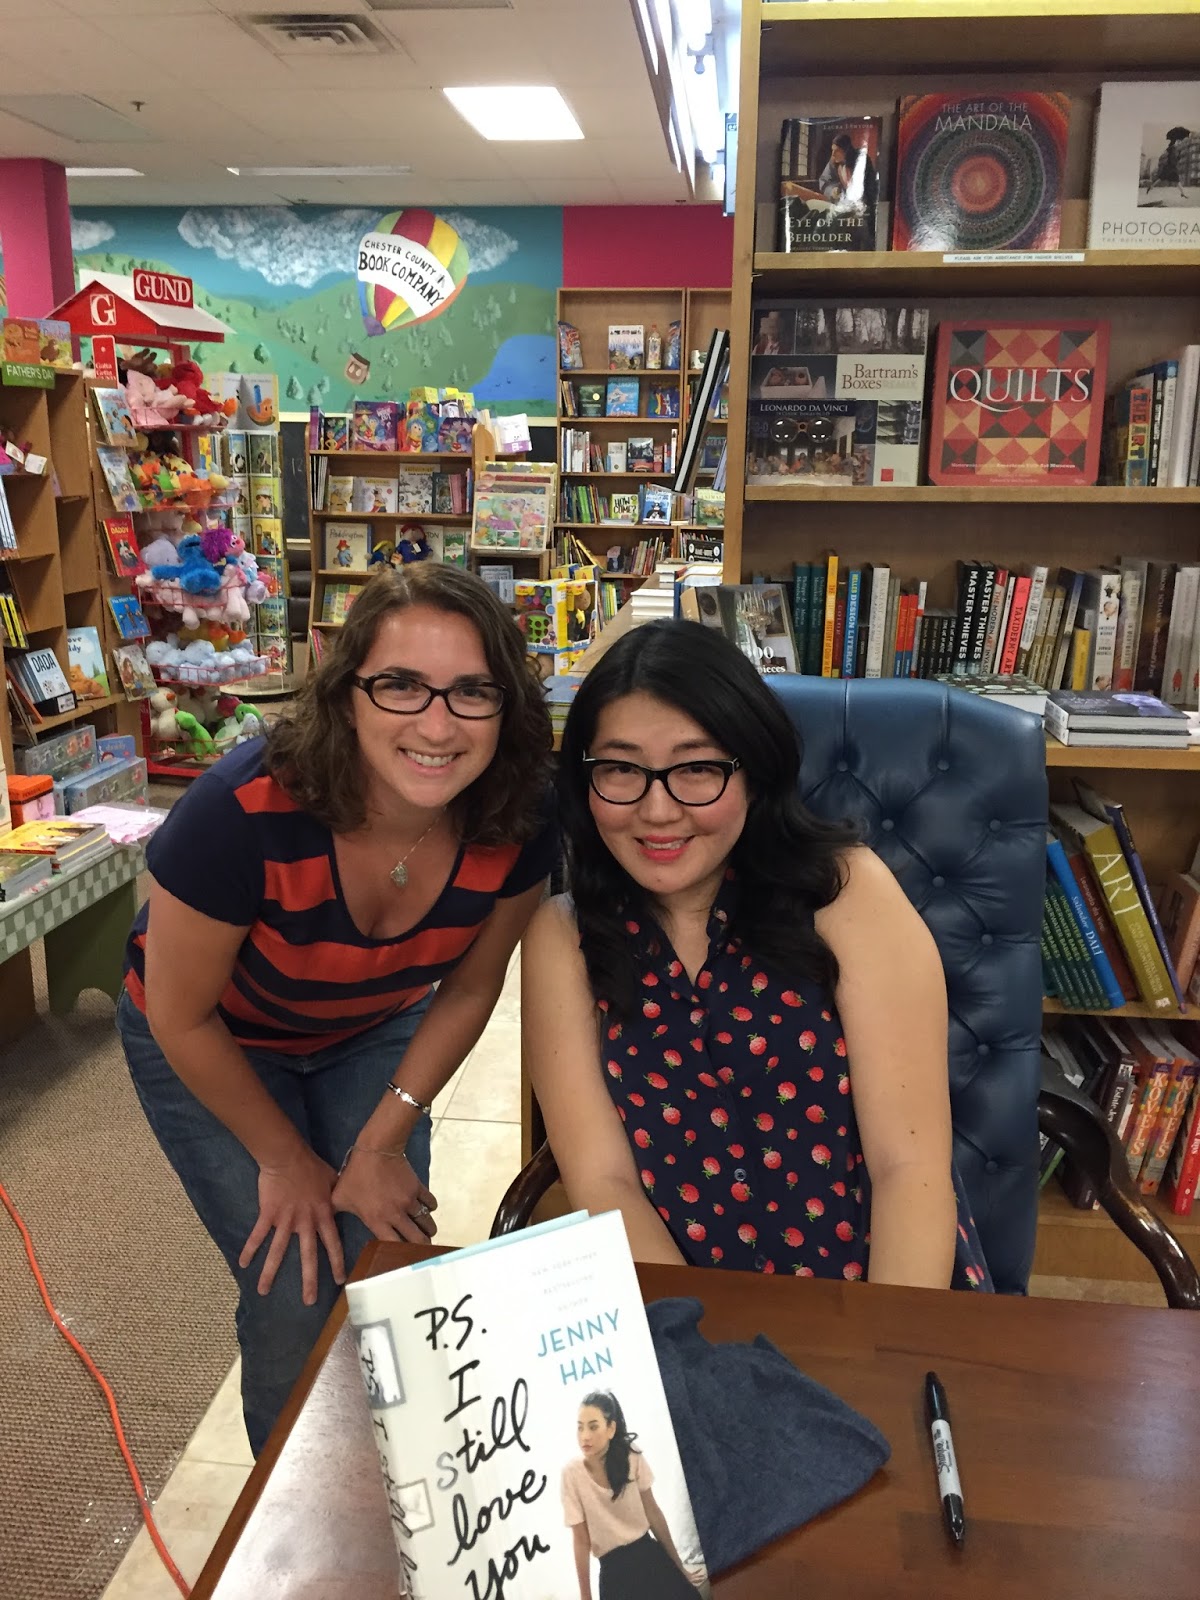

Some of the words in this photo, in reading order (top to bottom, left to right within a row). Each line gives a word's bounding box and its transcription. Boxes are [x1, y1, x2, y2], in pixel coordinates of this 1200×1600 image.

[935, 114, 1032, 131] MANDALA
[942, 103, 961, 113] THE
[965, 103, 984, 113] ART
[989, 102, 1003, 112] OF
[1009, 102, 1029, 112] THE
[789, 217, 812, 228] EYE
[817, 218, 834, 227] OF
[839, 218, 864, 227] THE
[789, 232, 852, 242] BEHOLDER
[1102, 222, 1200, 235] PHOTOGRA
[364, 240, 402, 255] CHESTER
[405, 251, 437, 276] COUNTY
[135, 272, 192, 304] GUND
[358, 251, 392, 272] BOOK
[391, 262, 445, 307] COMPANY
[6, 365, 42, 379] FATHER'S
[842, 374, 882, 389] Boxes
[854, 363, 918, 379] Bartram's
[950, 368, 1091, 413] QUILTS
[760, 403, 807, 412] LEONARDO
[809, 404, 821, 412] DA
[823, 404, 848, 413] VINCI
[614, 497, 630, 507] HOW
[965, 571, 978, 613] MASTER
[981, 571, 994, 613] MASTER
[1160, 569, 1168, 591] SIMON
[848, 595, 857, 628] DESIGN
[993, 591, 1001, 605] THE
[1156, 594, 1165, 623] SCHAMA
[989, 605, 999, 634] MODERN
[1007, 606, 1023, 655] TAXIDERMY
[845, 630, 855, 674] LITERACY
[959, 616, 971, 659] THIEVES
[974, 616, 987, 659] THIEVES
[31, 653, 57, 673] DADA
[1004, 658, 1013, 674] ART
[1080, 877, 1095, 905] Leonardo
[1092, 853, 1145, 916] ART
[1071, 896, 1089, 928] Salvador
[1050, 894, 1071, 938] UNDERWATER
[1068, 939, 1081, 962] BABIES
[1060, 895, 1081, 938] UNDERWATER
[1078, 939, 1091, 962] BABIES
[1059, 938, 1073, 962] BABIES
[1111, 1086, 1124, 1109] Estate
[538, 1308, 619, 1357] JENNY
[559, 1347, 613, 1386] HAN
[444, 1360, 481, 1422] I
[447, 1469, 547, 1566] love
